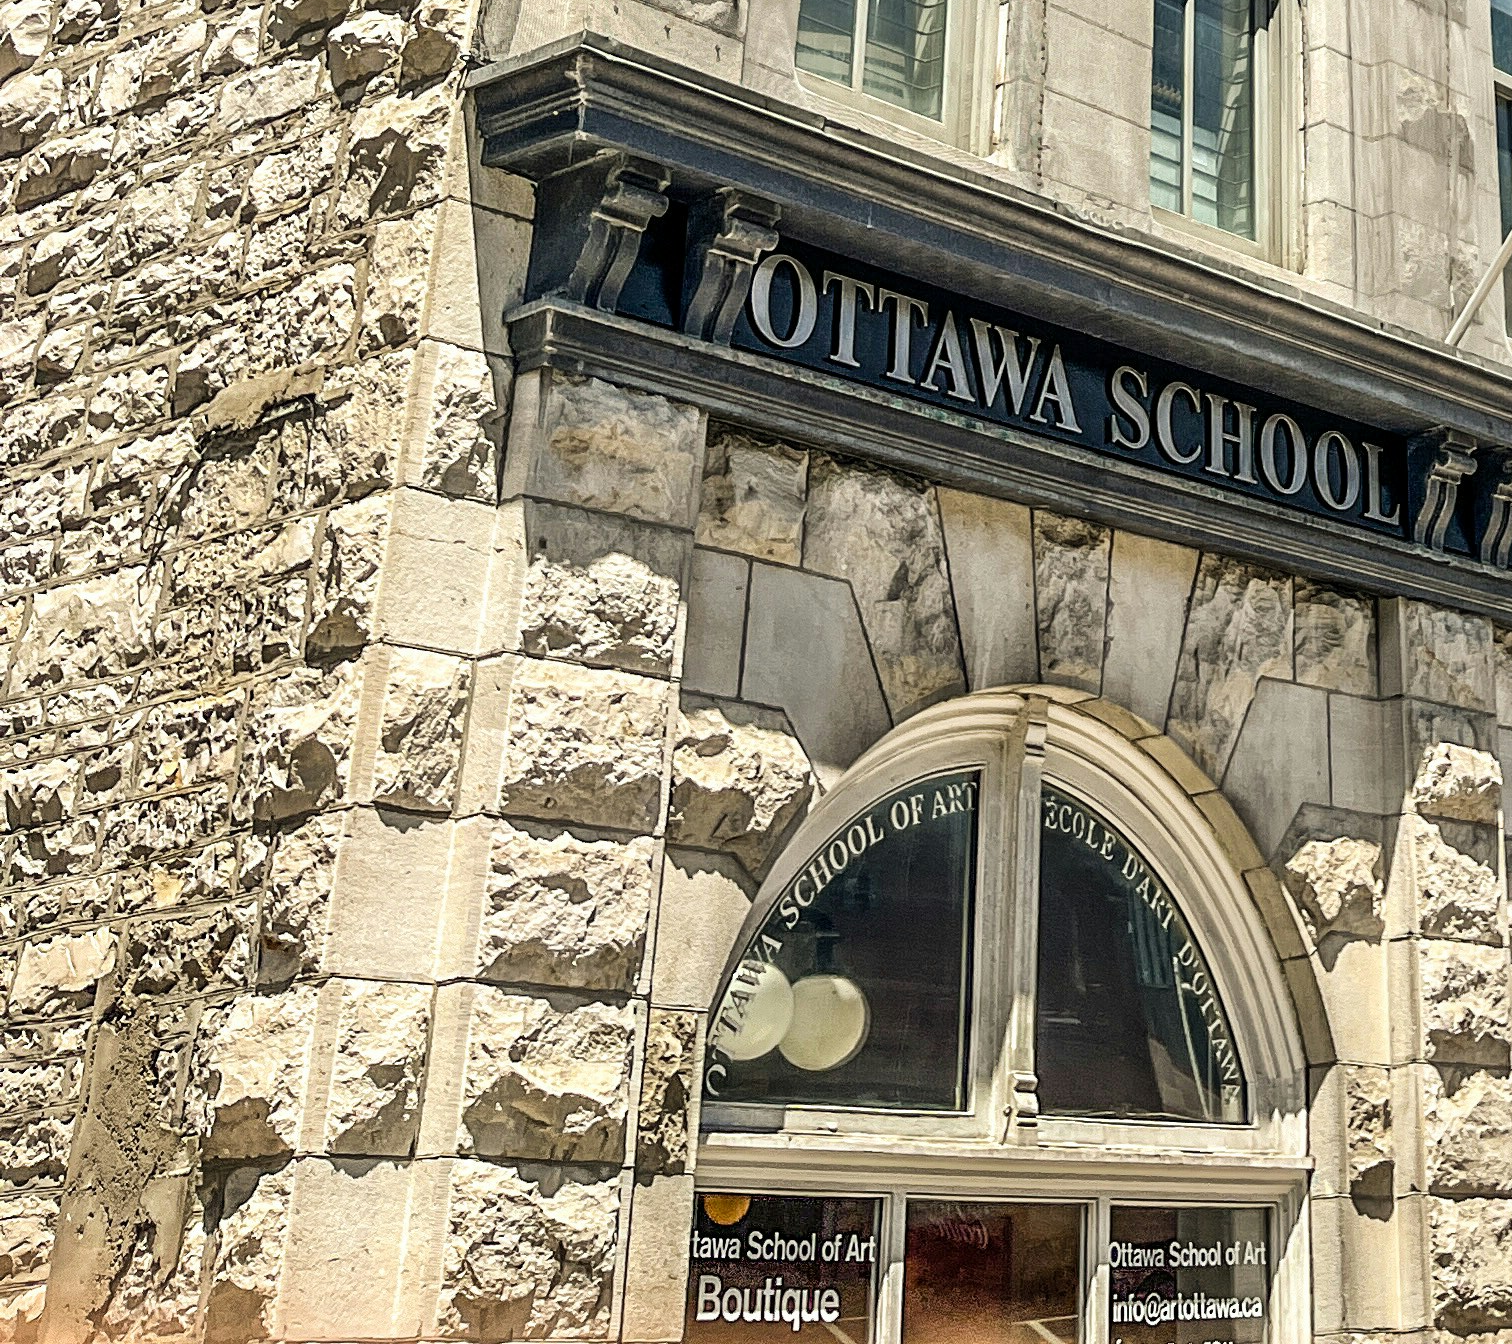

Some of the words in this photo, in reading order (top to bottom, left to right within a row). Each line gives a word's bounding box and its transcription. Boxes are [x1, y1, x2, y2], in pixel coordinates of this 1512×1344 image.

[750, 254, 1082, 434] OTTAWA
[1109, 365, 1400, 527] SCHOOL
[779, 814, 885, 930] SCHOOL
[890, 794, 925, 831] OF
[931, 782, 978, 820] ART
[1044, 795, 1117, 861] ÉCOLE
[746, 1230, 816, 1262] School
[822, 1233, 843, 1262] of
[845, 1233, 876, 1263] Art
[1109, 1241, 1165, 1268] Ottawa
[1169, 1241, 1222, 1268] School
[1225, 1240, 1241, 1266] of
[1243, 1240, 1267, 1266] Art
[696, 1274, 840, 1331] Boutique
[1112, 1292, 1264, 1326] info@artottawa.ca
